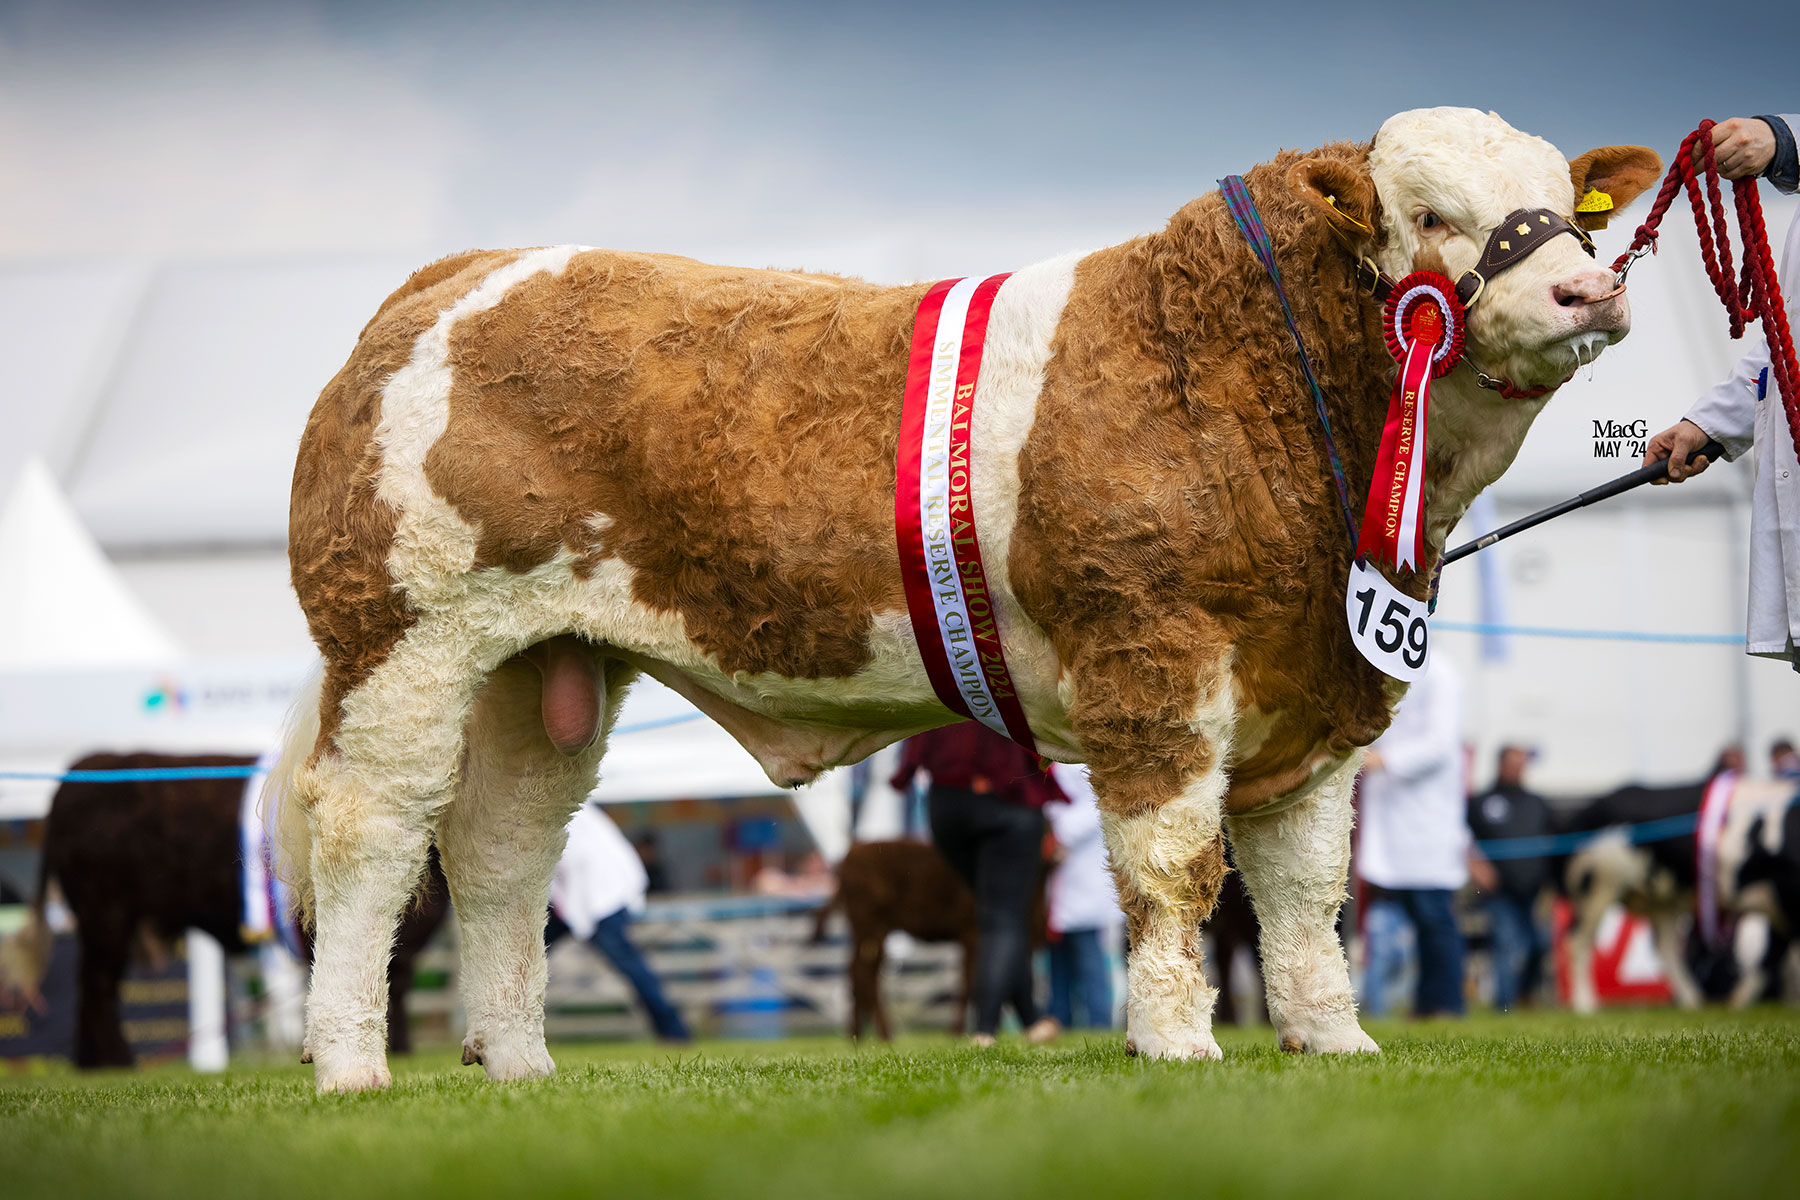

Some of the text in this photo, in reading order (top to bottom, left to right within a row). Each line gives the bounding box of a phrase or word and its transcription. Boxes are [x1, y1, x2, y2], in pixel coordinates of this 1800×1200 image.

[926, 341, 997, 719] SIMMENTAL RESERVE CHAMPION
[950, 380, 1015, 699] BALMORAL SHOW 2024
[1385, 390, 1415, 538] RESERVE CHAMPION
[1356, 587, 1428, 669] 159
